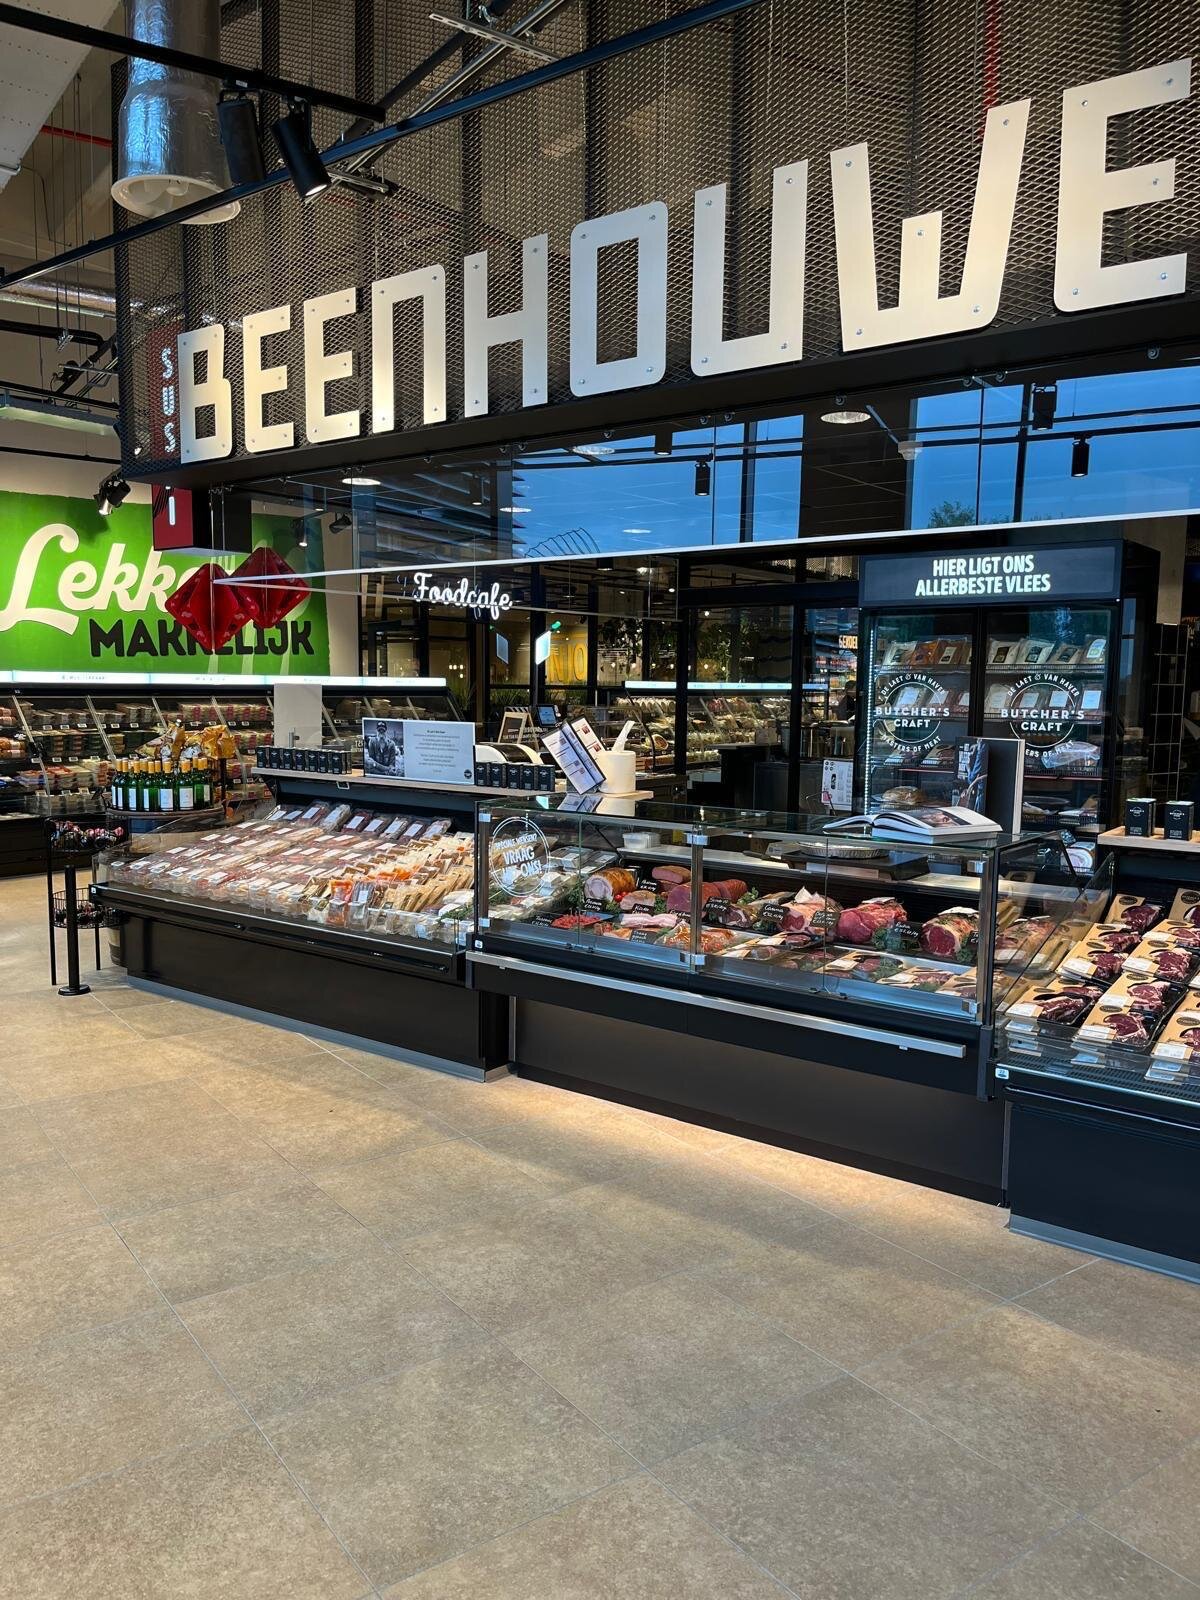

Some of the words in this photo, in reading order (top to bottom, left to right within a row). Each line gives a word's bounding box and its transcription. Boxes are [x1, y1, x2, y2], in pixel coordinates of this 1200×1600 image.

[932, 558, 967, 577] HIER
[968, 556, 1002, 575] LIGT
[1002, 554, 1035, 574] ONS
[0, 523, 203, 635] Lekk
[915, 576, 1003, 597] ALLERBESTE
[1005, 573, 1051, 593] VLEES
[89, 618, 315, 657] MAKLIJK
[881, 686, 889, 696] DE
[888, 675, 904, 688] LAET
[913, 673, 927, 681] VAN
[1007, 687, 1017, 697] DE
[1015, 675, 1032, 688] LAET
[1043, 673, 1059, 681] VAN
[1059, 678, 1080, 697] HAVER
[875, 706, 950, 717] BUTCHER'S
[1001, 708, 1085, 720] BUTCHER'S
[893, 719, 931, 728] CRAFT
[1020, 721, 1063, 732] CRAFT
[924, 735, 941, 750] MEAT
[502, 845, 535, 865] VRAAG
